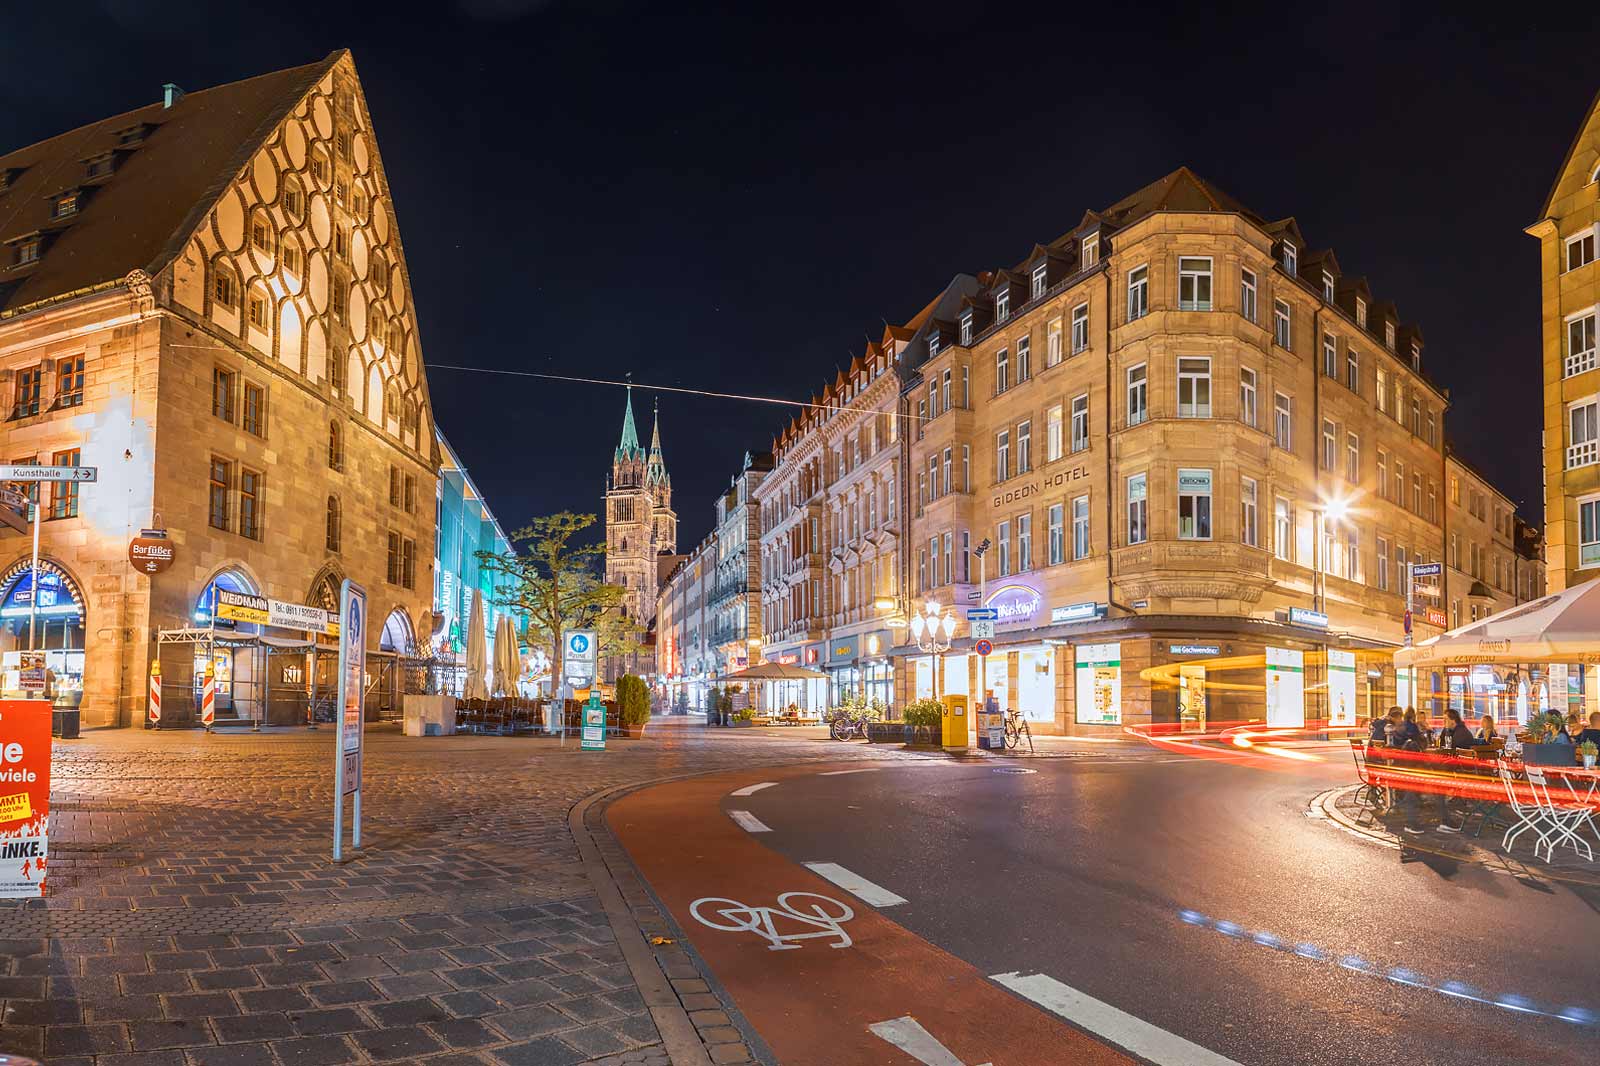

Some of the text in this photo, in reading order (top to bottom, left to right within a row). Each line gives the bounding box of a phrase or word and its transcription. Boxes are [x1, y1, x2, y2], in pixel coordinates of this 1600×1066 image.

[13, 468, 61, 478] Kunsthalle
[993, 466, 1090, 507] GIDEON HOTEL
[133, 544, 172, 555] Barfüßer
[1414, 565, 1439, 575] Königstraße
[443, 570, 453, 606] KAUFHOF
[220, 591, 268, 611] WEIDMANN
[1430, 613, 1447, 626] HOTEL
[0, 768, 36, 782] viele
